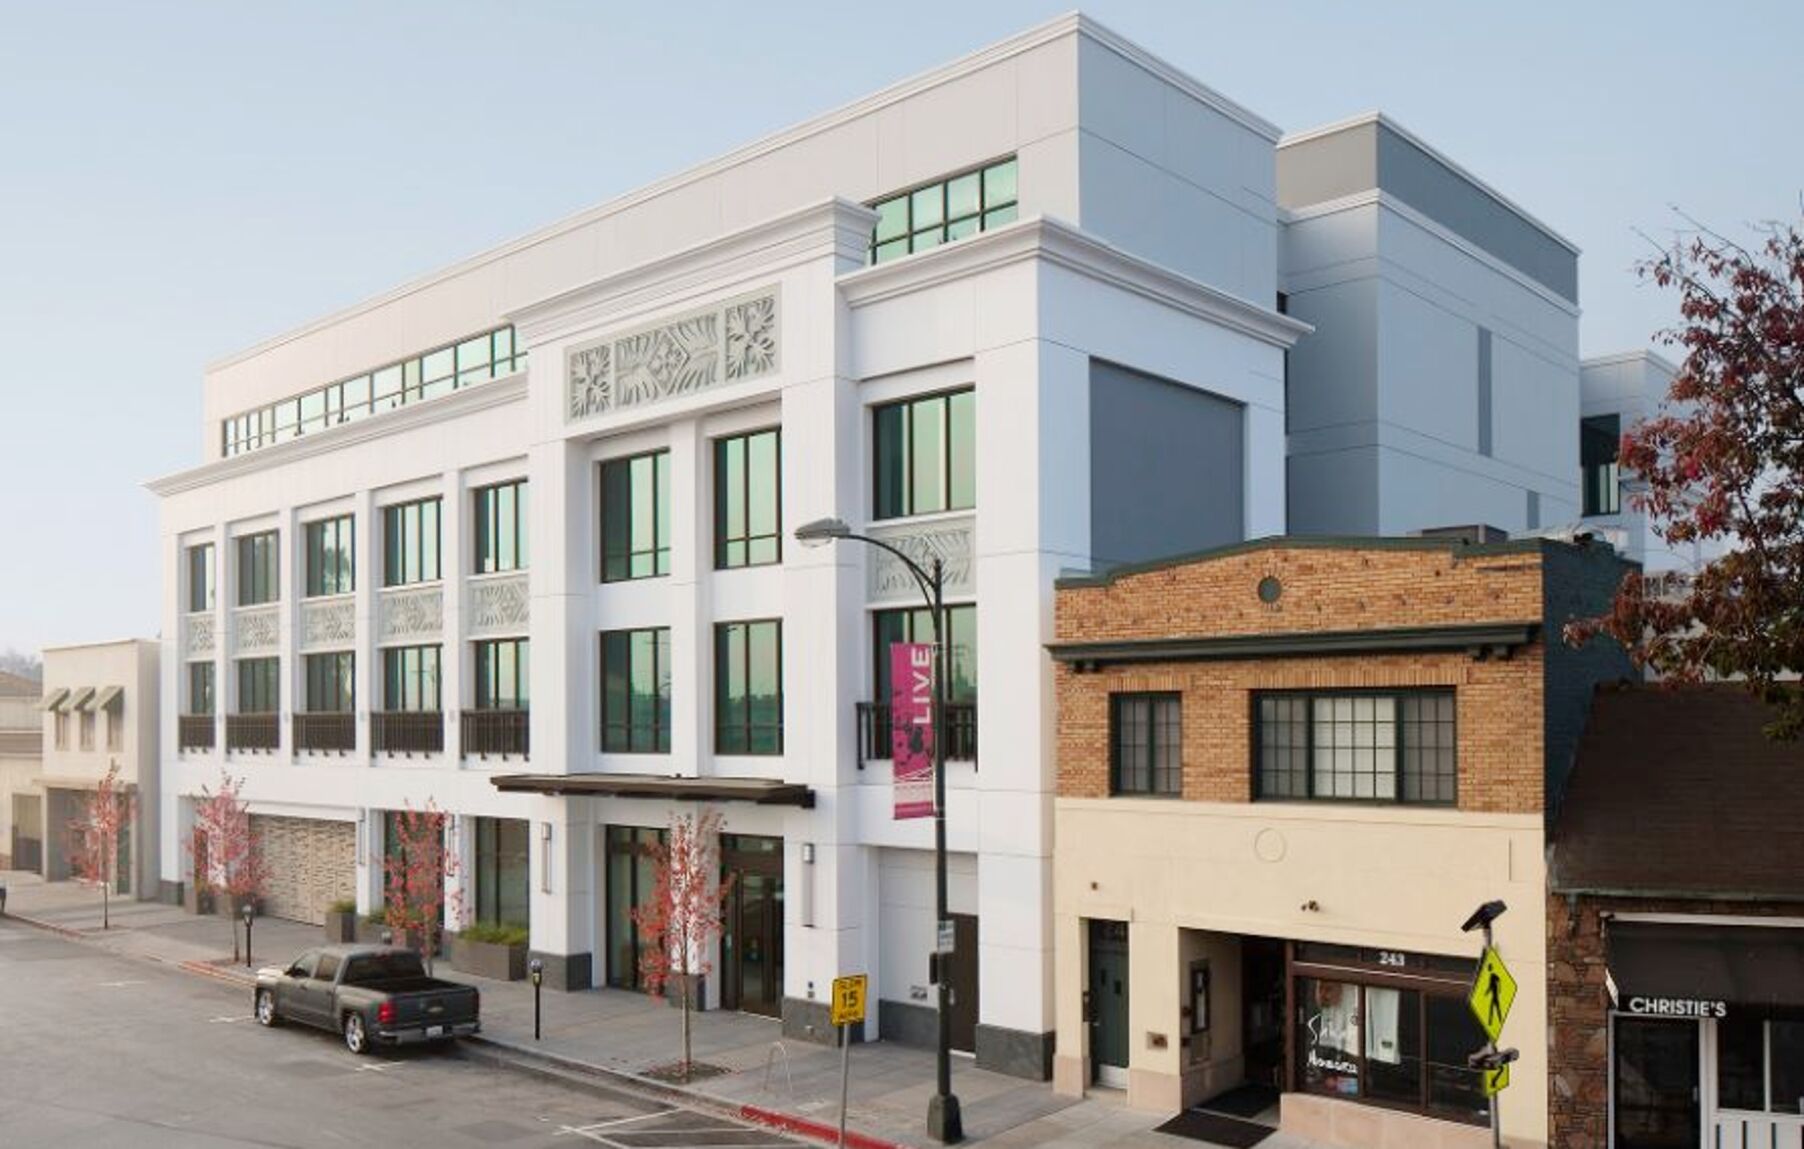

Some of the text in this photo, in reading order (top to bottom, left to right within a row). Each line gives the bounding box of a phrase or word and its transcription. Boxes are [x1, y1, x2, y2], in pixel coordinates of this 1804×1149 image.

[912, 647, 930, 724] LIVE
[1379, 951, 1405, 966] 243
[841, 990, 859, 1009] 15
[1629, 997, 1727, 1017] CHRISTIE'S
